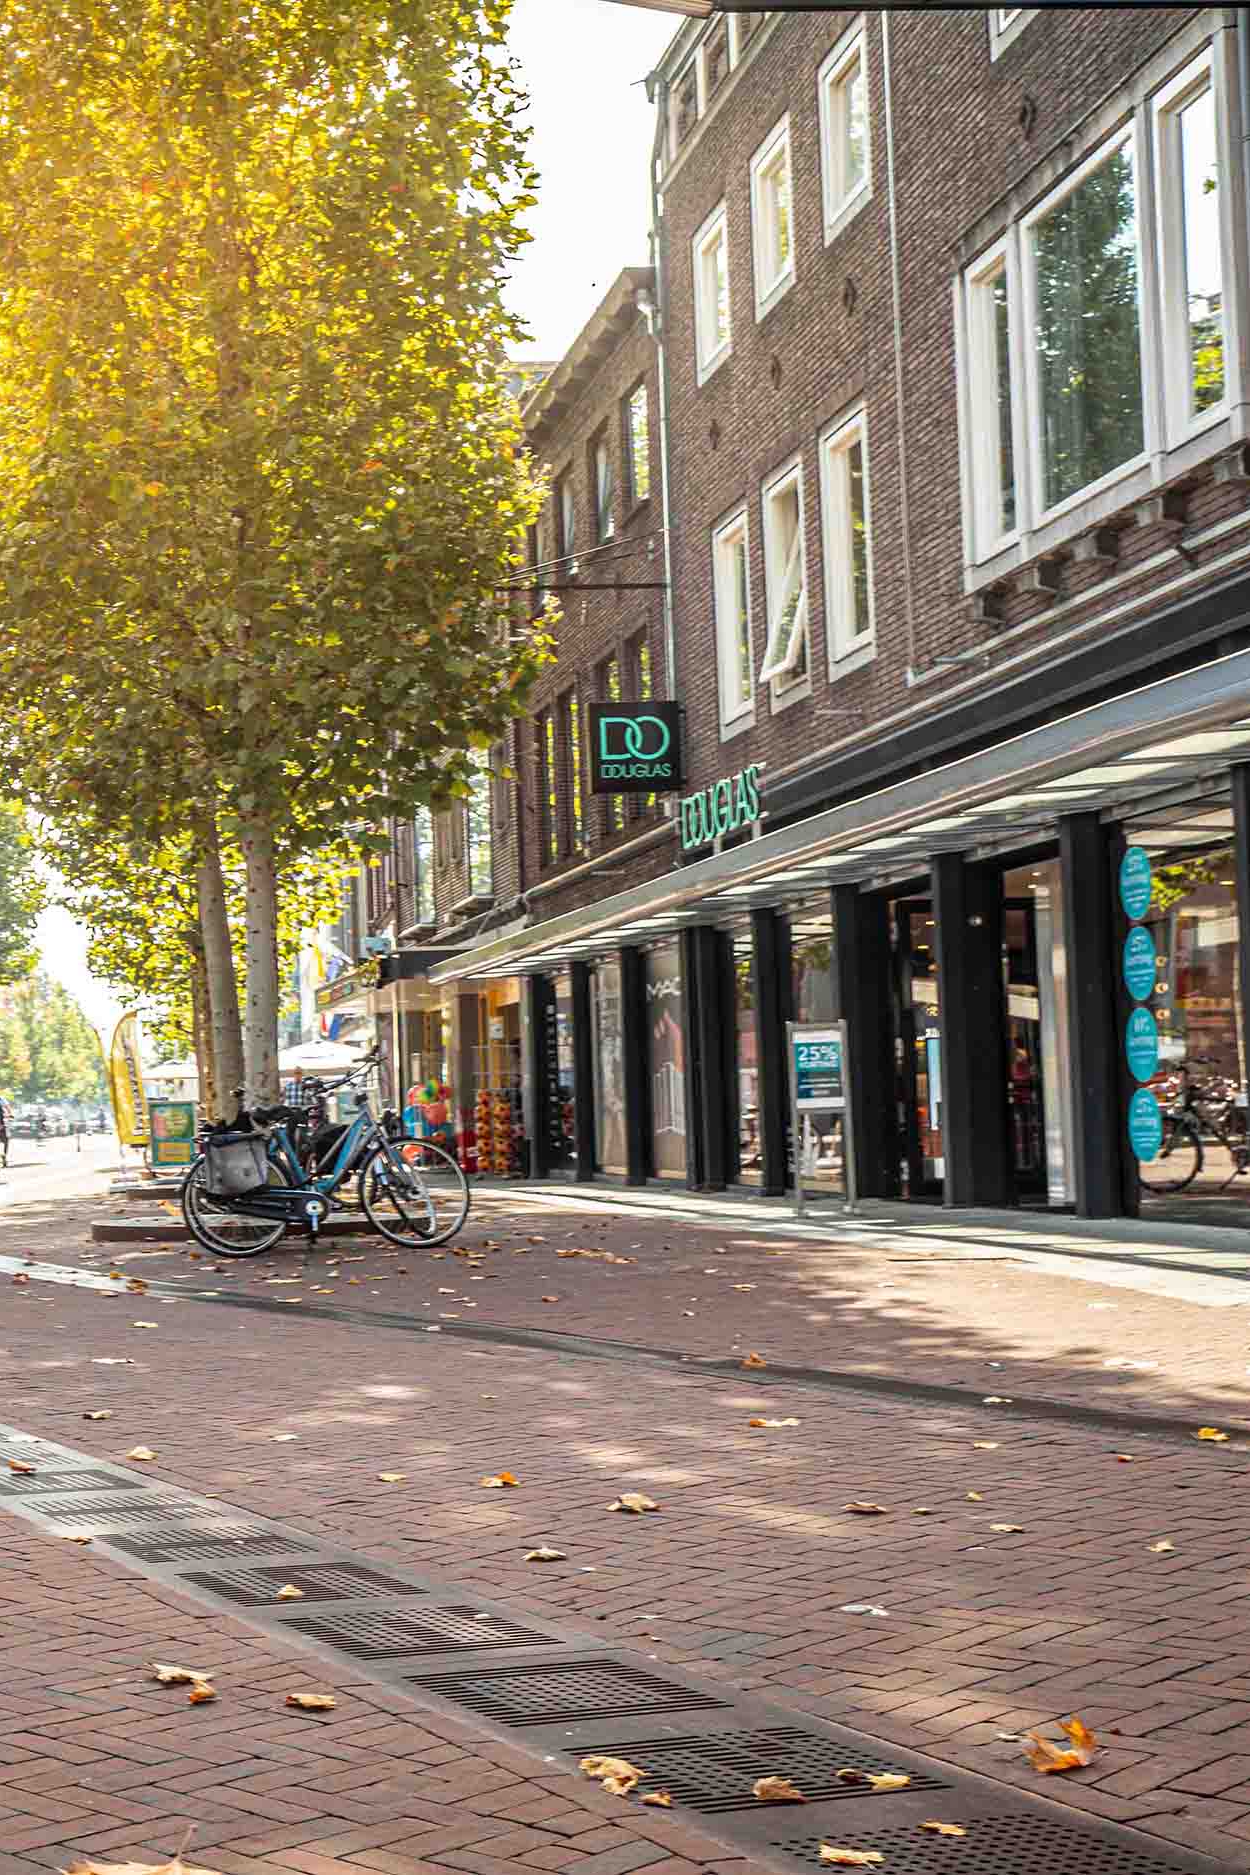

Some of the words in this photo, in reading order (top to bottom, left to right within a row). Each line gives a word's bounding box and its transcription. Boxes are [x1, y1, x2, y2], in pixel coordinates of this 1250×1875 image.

[602, 764, 671, 778] DOUGLAS
[681, 765, 760, 849] DOUGLAS
[798, 1046, 839, 1061] 25%
